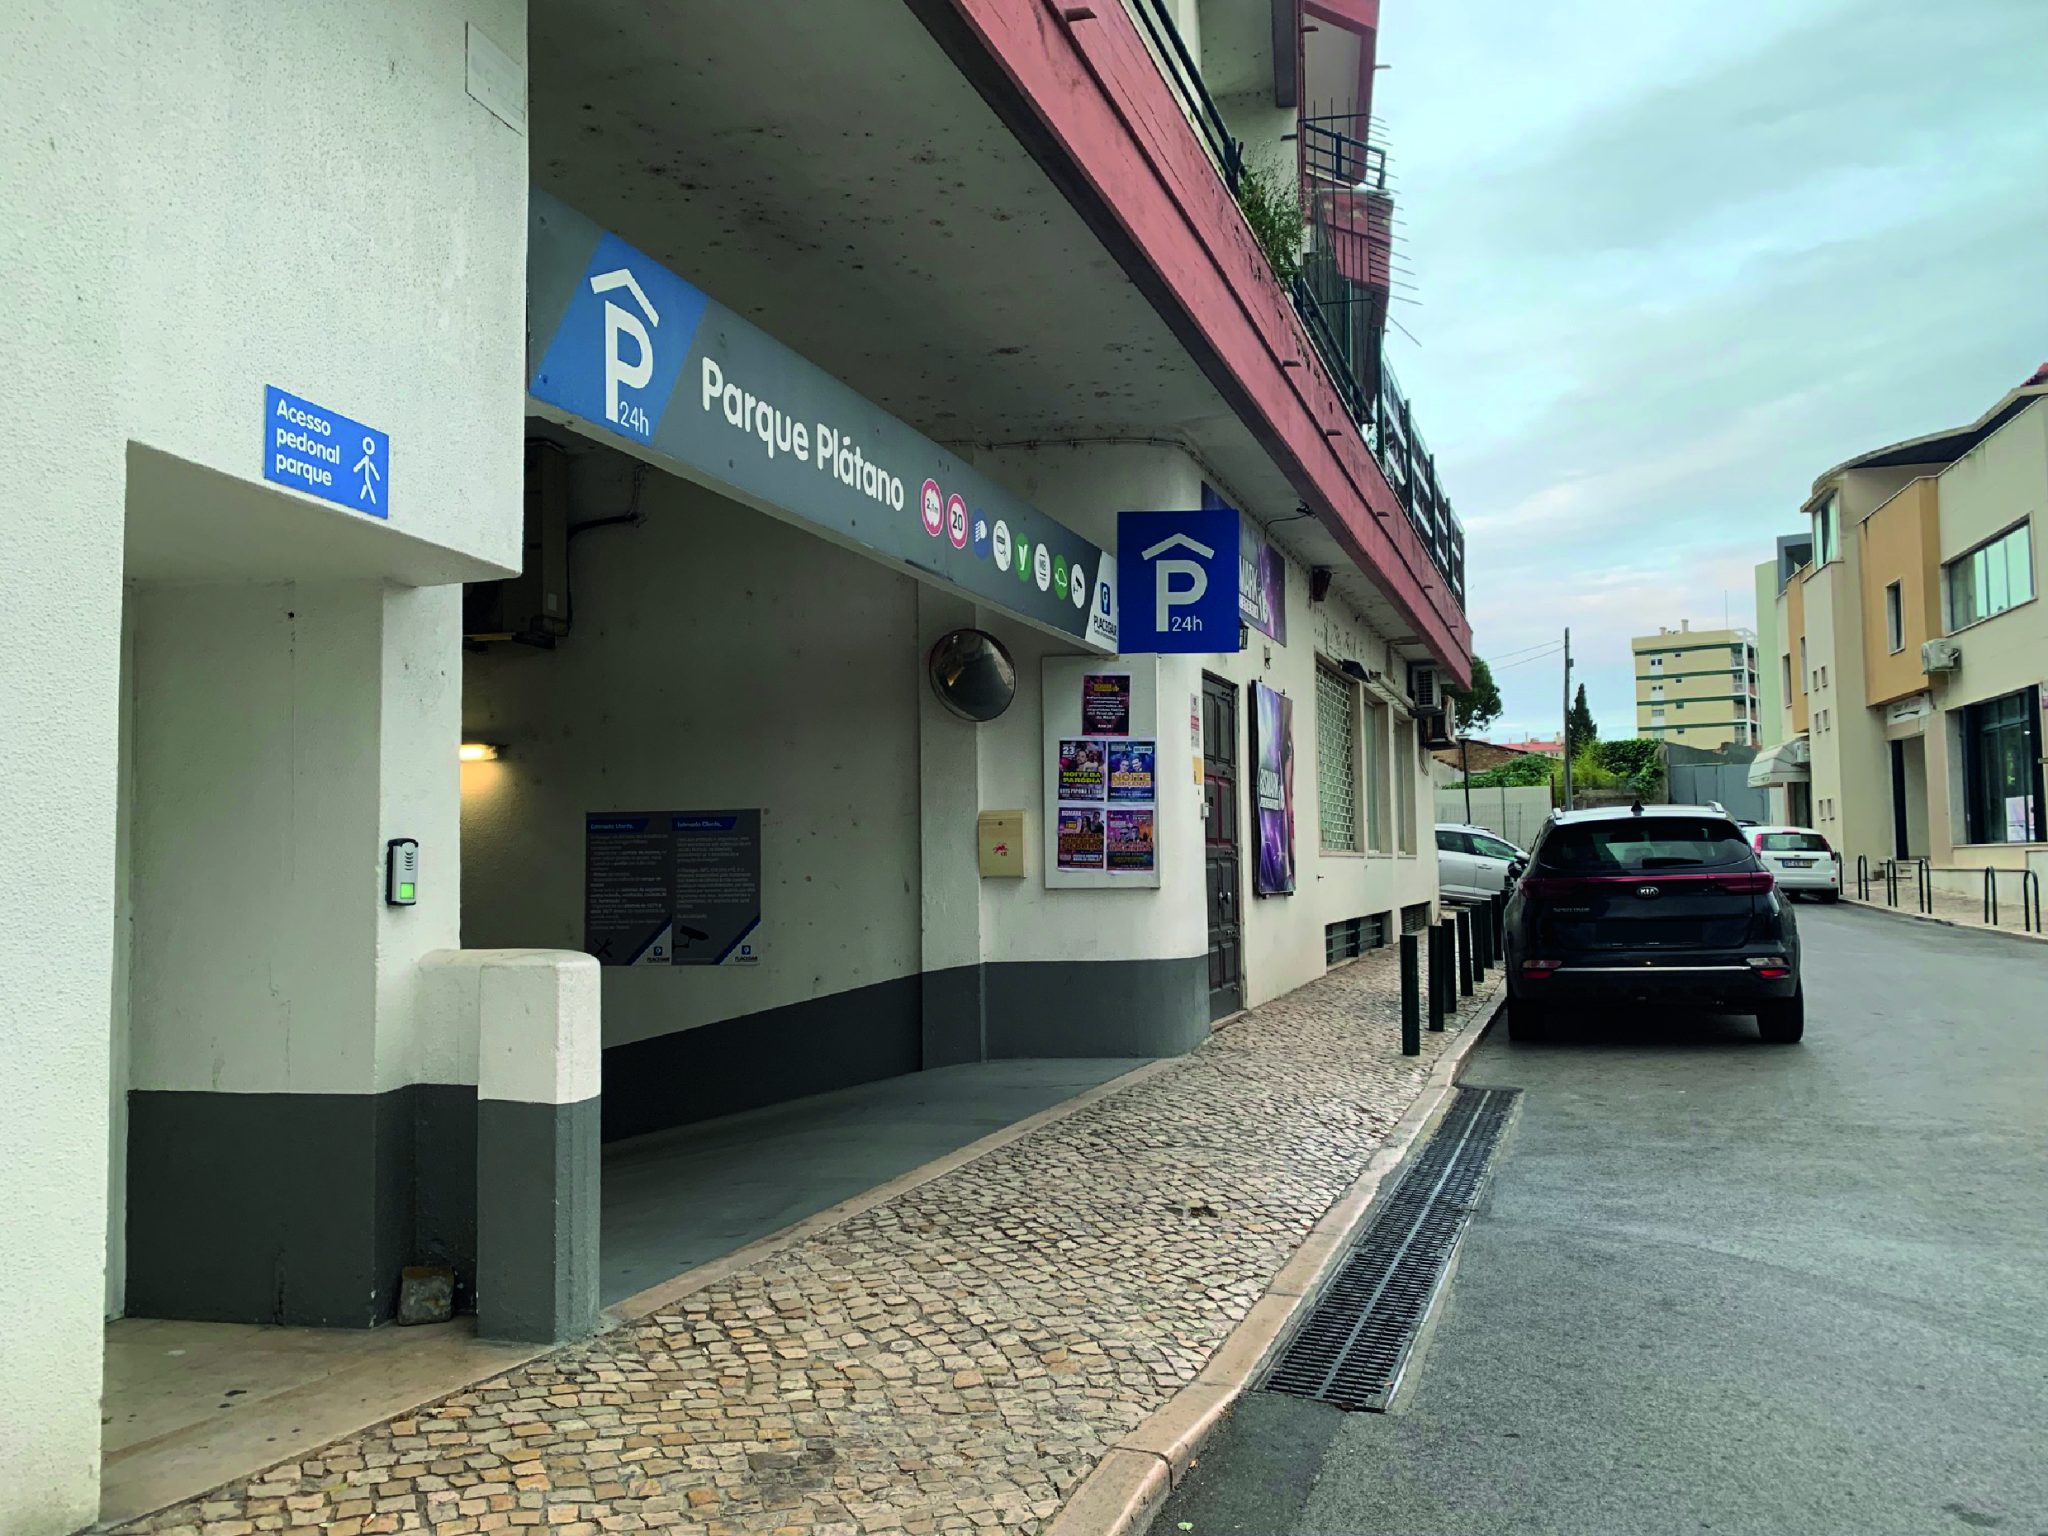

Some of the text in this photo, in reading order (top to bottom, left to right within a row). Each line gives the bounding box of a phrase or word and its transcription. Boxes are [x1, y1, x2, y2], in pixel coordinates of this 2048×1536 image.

[605, 300, 653, 423] P
[276, 399, 331, 437] Acesso
[618, 401, 649, 437] 24h
[702, 356, 904, 511] Parque Plátano
[276, 427, 341, 465] pedonal
[276, 453, 333, 486] parque
[952, 510, 963, 532] 20
[1156, 560, 1208, 632] P
[1171, 614, 1203, 632] 24h
